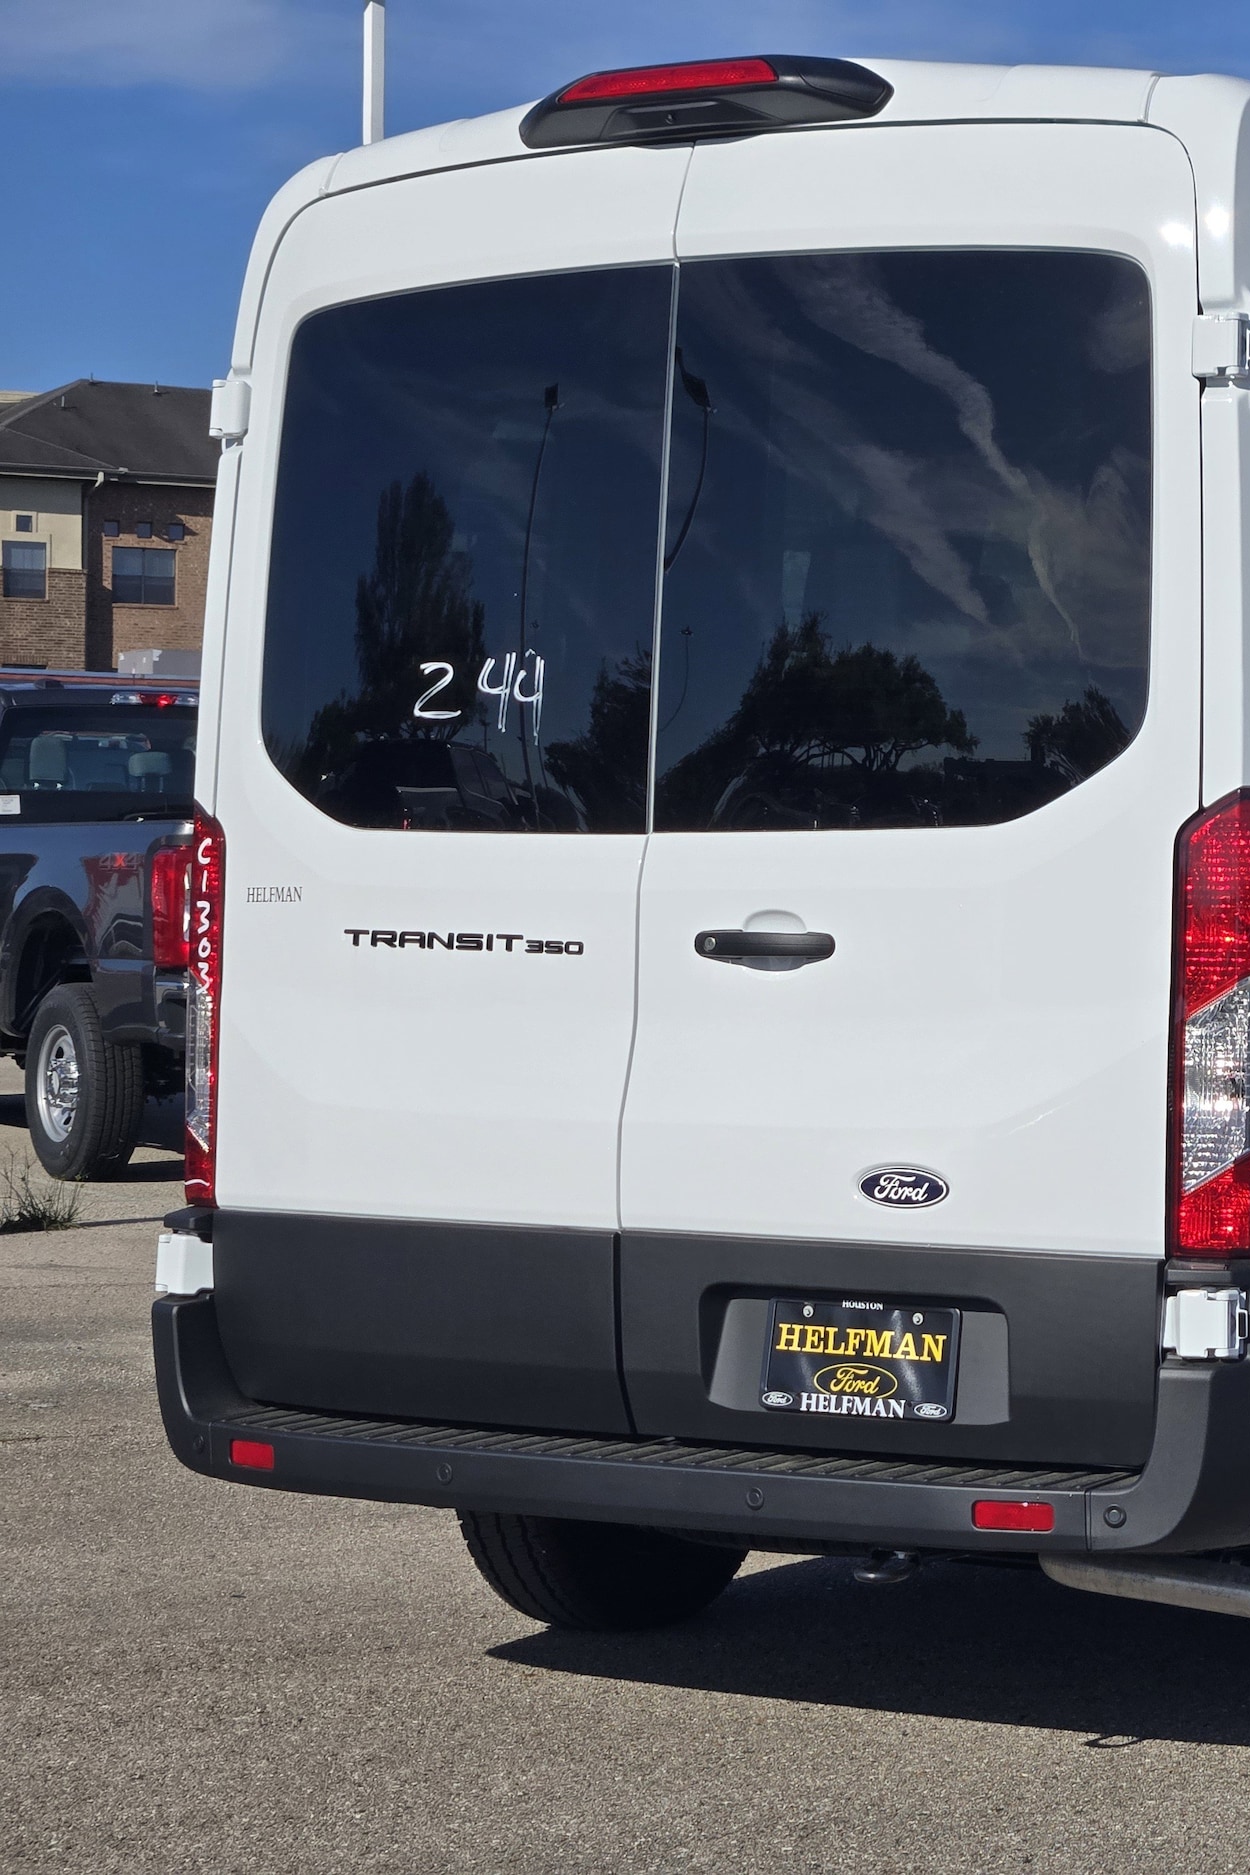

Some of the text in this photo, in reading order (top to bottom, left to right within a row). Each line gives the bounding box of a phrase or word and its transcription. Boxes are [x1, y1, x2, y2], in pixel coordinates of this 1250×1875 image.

[246, 886, 303, 903] HELFMAN
[343, 929, 584, 956] TRANSIT 350
[873, 1173, 930, 1201] Ford
[841, 1299, 884, 1311] HOUSTON
[775, 1323, 947, 1363] HELFMAN
[829, 1367, 881, 1394] Ford
[799, 1392, 906, 1419] HELFMAN
